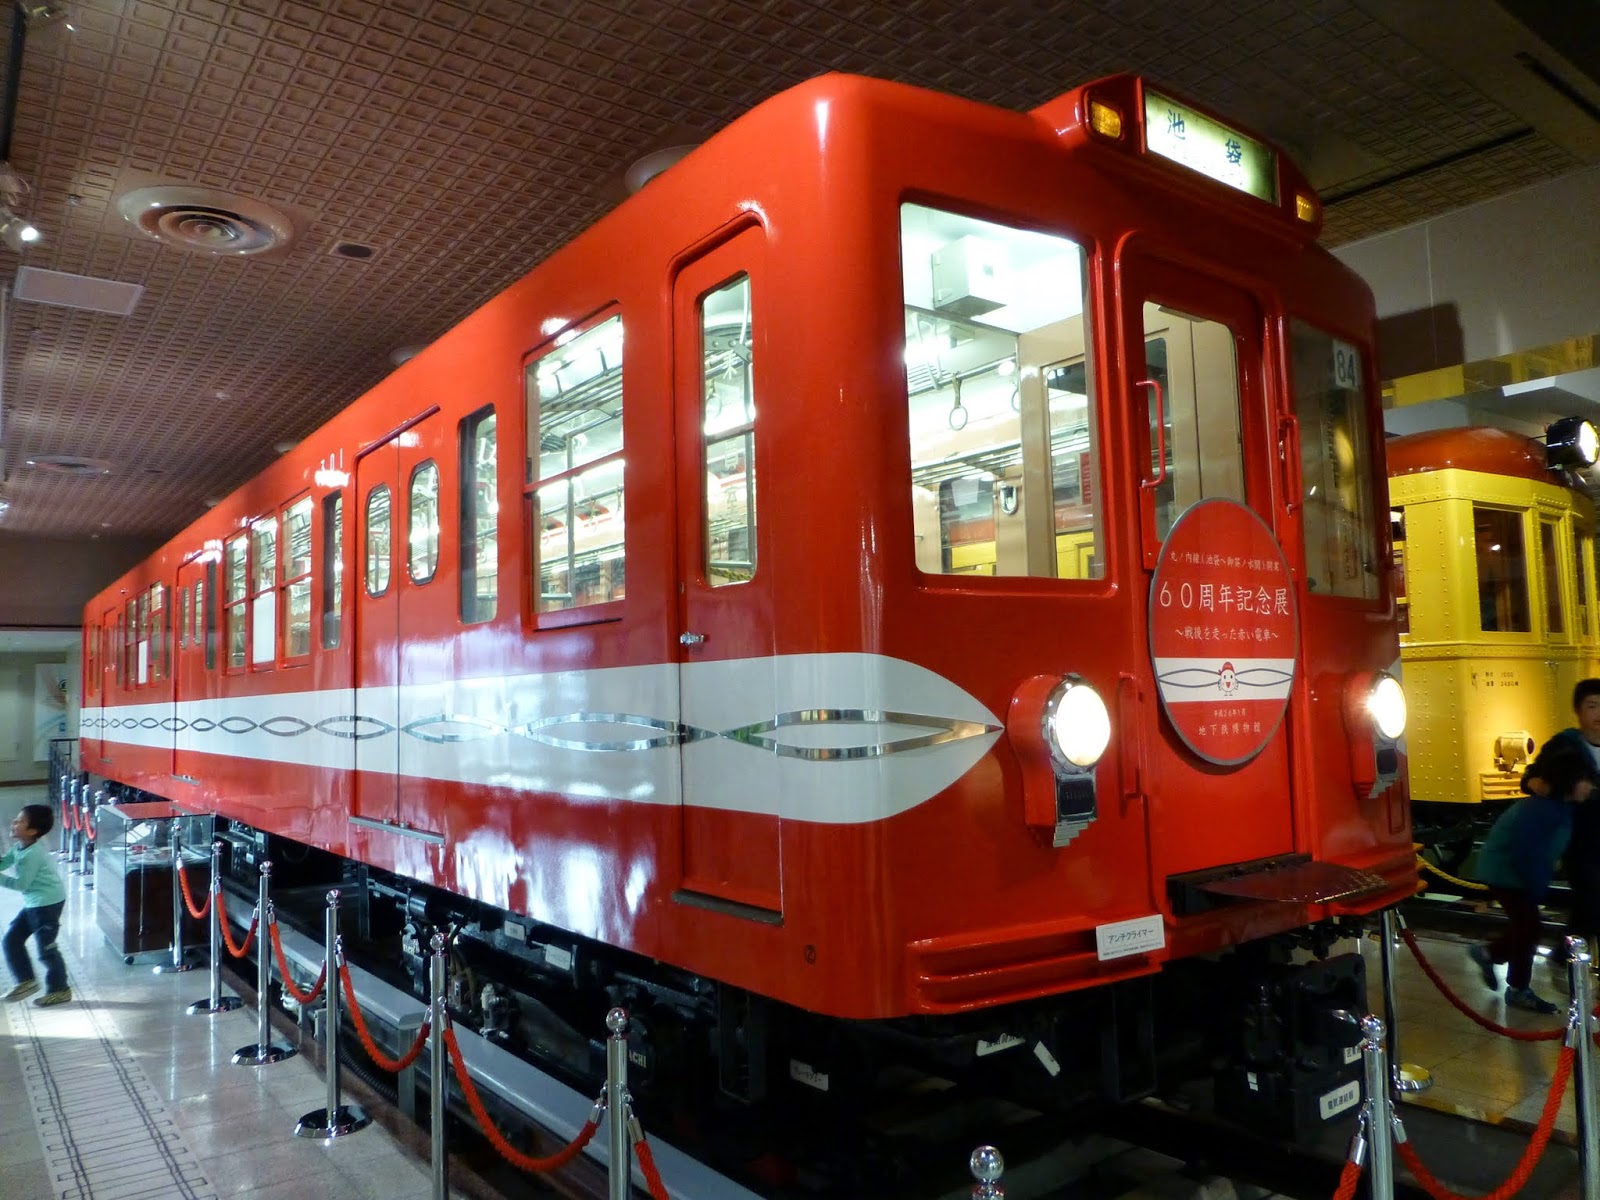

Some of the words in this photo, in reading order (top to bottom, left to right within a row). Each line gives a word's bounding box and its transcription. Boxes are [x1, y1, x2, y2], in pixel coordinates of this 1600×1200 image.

[1166, 108, 1243, 168] 池袋
[1336, 349, 1356, 387] 84
[1158, 580, 1290, 616] 60周年記念展
[1198, 721, 1261, 736] 地下鉄博物館
[1107, 928, 1154, 945] アンチクライマー
